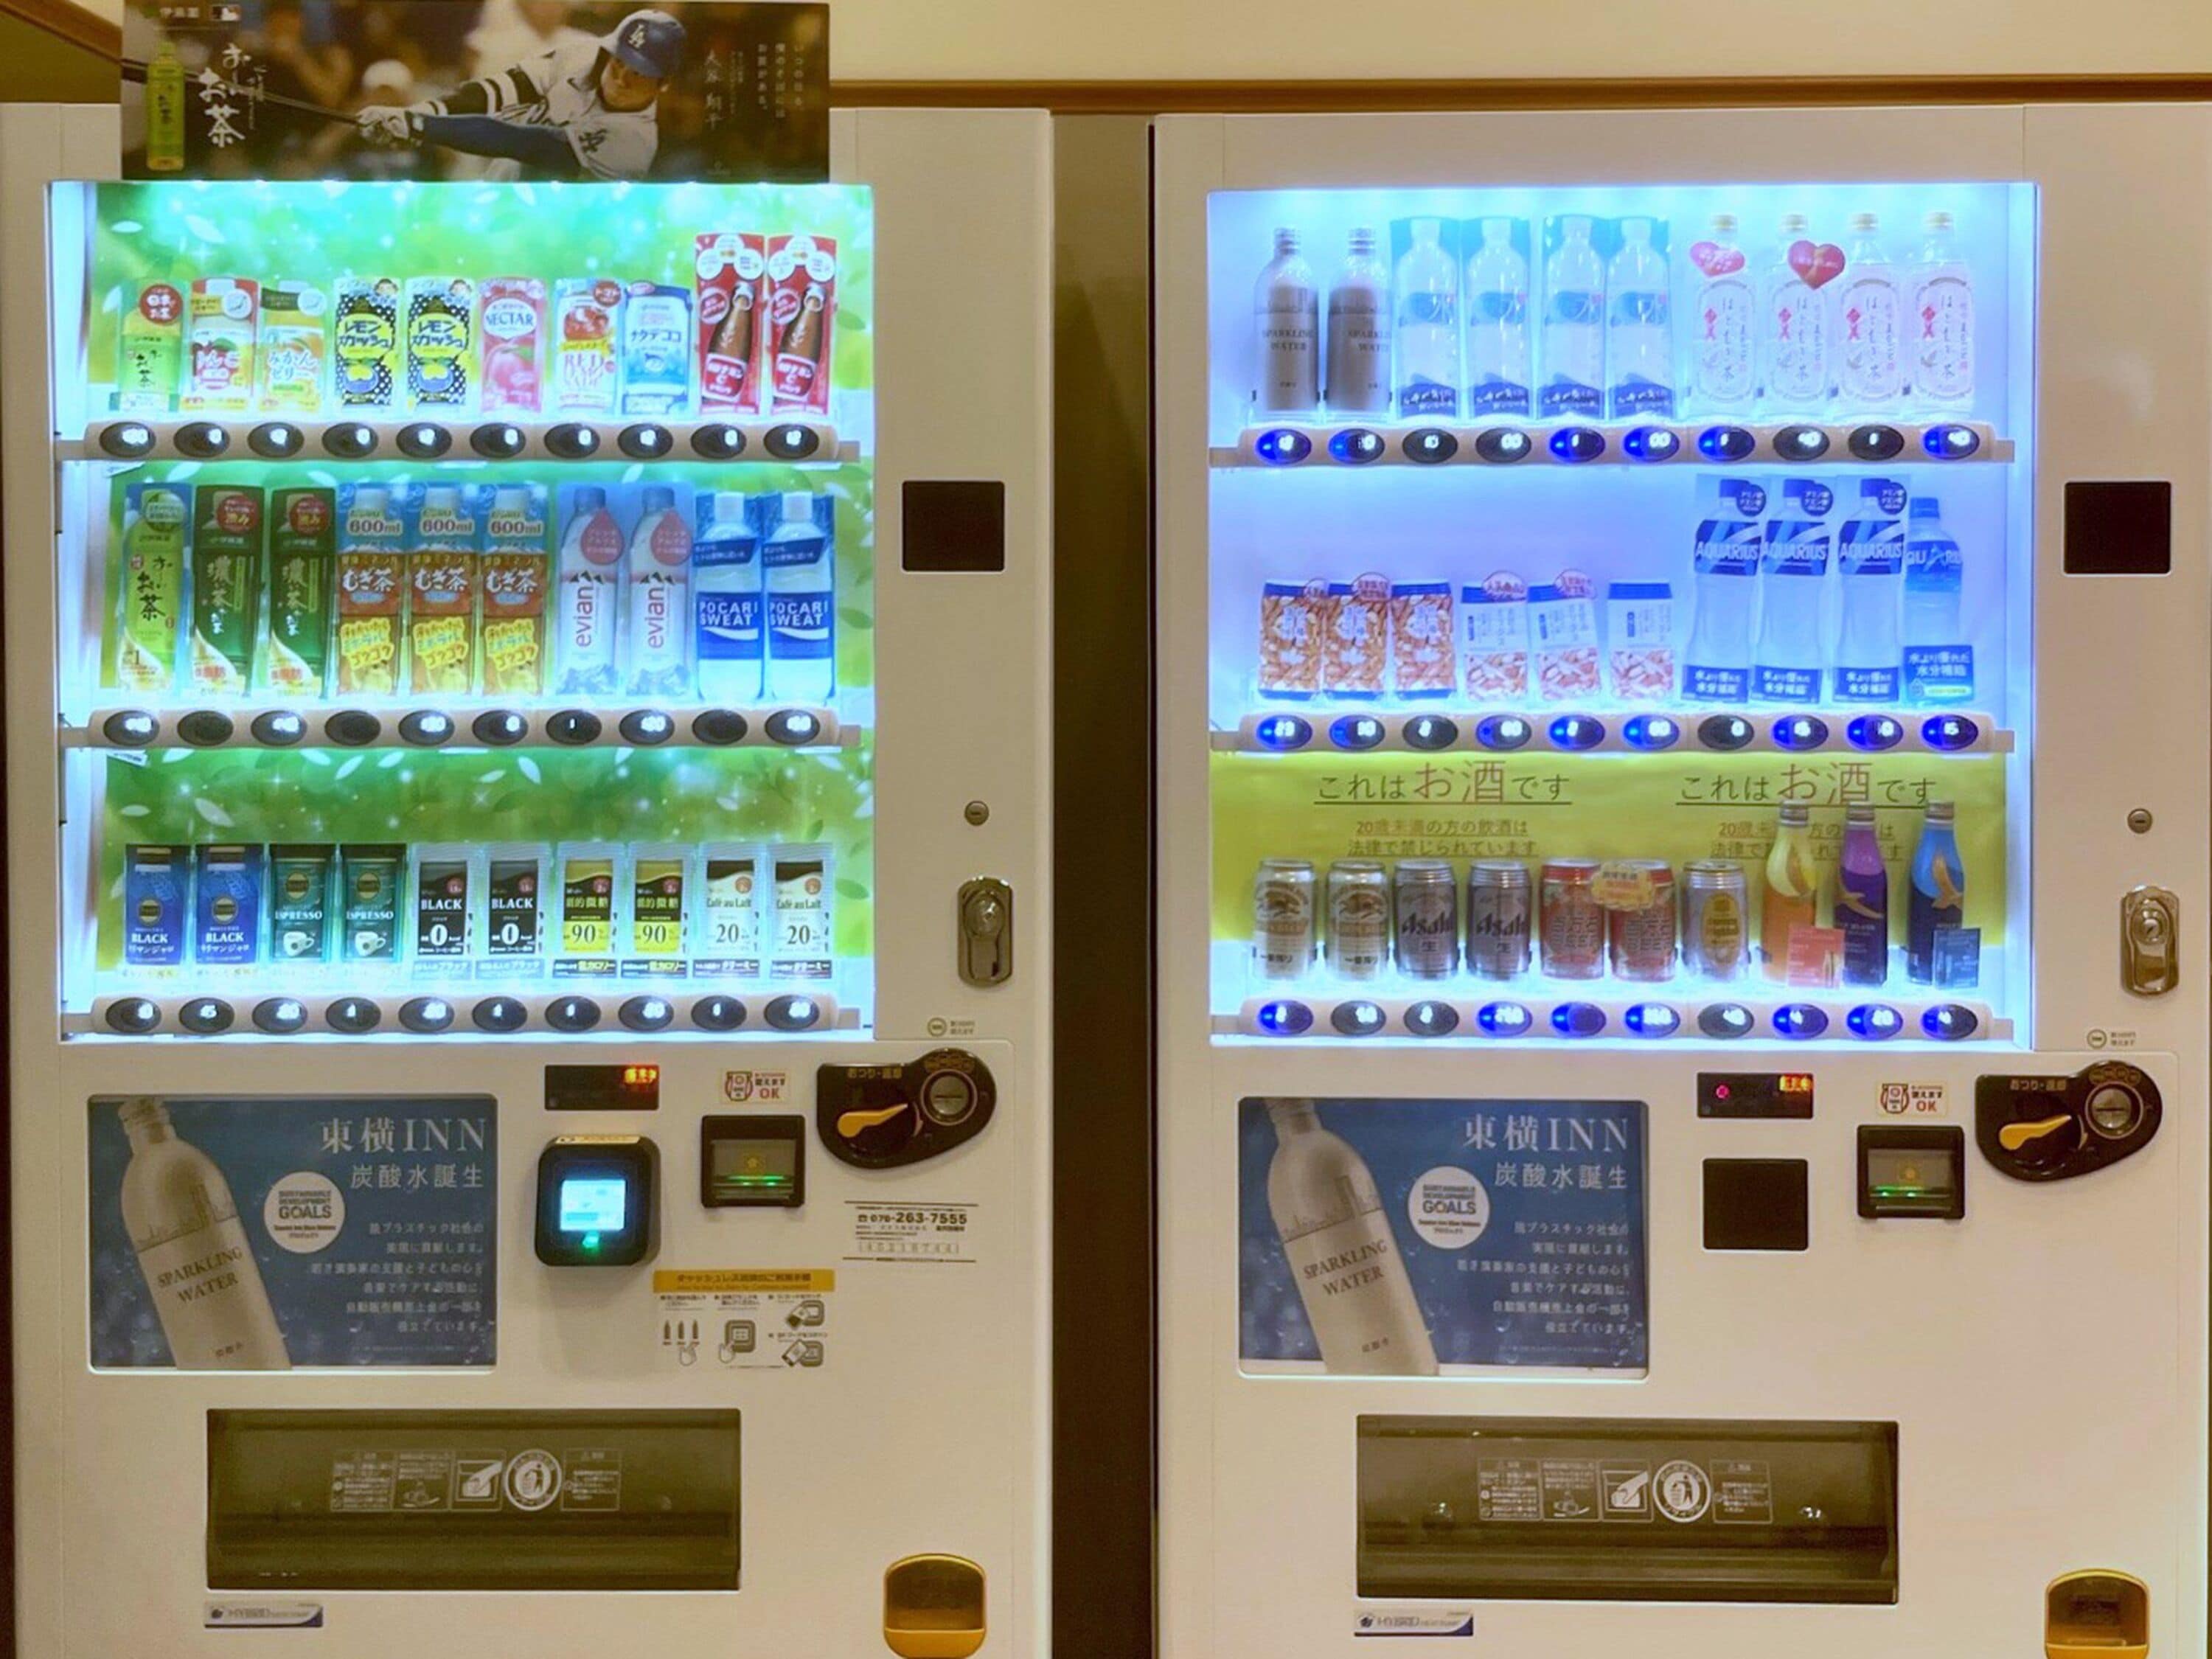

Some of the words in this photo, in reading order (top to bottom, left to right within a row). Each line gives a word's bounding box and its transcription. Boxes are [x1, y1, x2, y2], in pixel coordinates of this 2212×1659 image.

[486, 312, 534, 326] NECTAR
[1840, 543, 1902, 559] AQUARIUS
[343, 568, 395, 592] むぎ茶
[414, 568, 467, 592] むぎ茶
[486, 568, 538, 594] むぎ茶
[574, 586, 592, 648] evian
[644, 586, 664, 649] evian
[700, 602, 758, 614] POCARI
[770, 602, 829, 614] POCARI
[700, 613, 752, 626] SWEAT
[771, 613, 823, 626] SWEAT
[1318, 759, 1570, 803] これはお酒です
[1681, 761, 1938, 804] これはお酒です
[421, 899, 462, 910] BLACK
[492, 897, 533, 909] BLACK
[206, 932, 244, 943] BLACK
[571, 925, 596, 943] 90
[642, 925, 667, 944] 90
[716, 924, 738, 944] 20
[787, 925, 810, 945] 20
[759, 1088, 779, 1099] OK
[1916, 1100, 1937, 1112] OK
[321, 1116, 487, 1155] 東横INN
[1463, 1113, 1629, 1152] 東横INN
[350, 1164, 484, 1189] 炭酸水誕生
[1495, 1162, 1628, 1189] 炭酸水誕生
[279, 1205, 331, 1220] GOALS
[1422, 1200, 1476, 1214] GOALS
[157, 1245, 243, 1290] SPARKLING
[1302, 1239, 1388, 1281] SPARKLING
[177, 1272, 238, 1304] WATER
[1323, 1265, 1385, 1298] WATER
